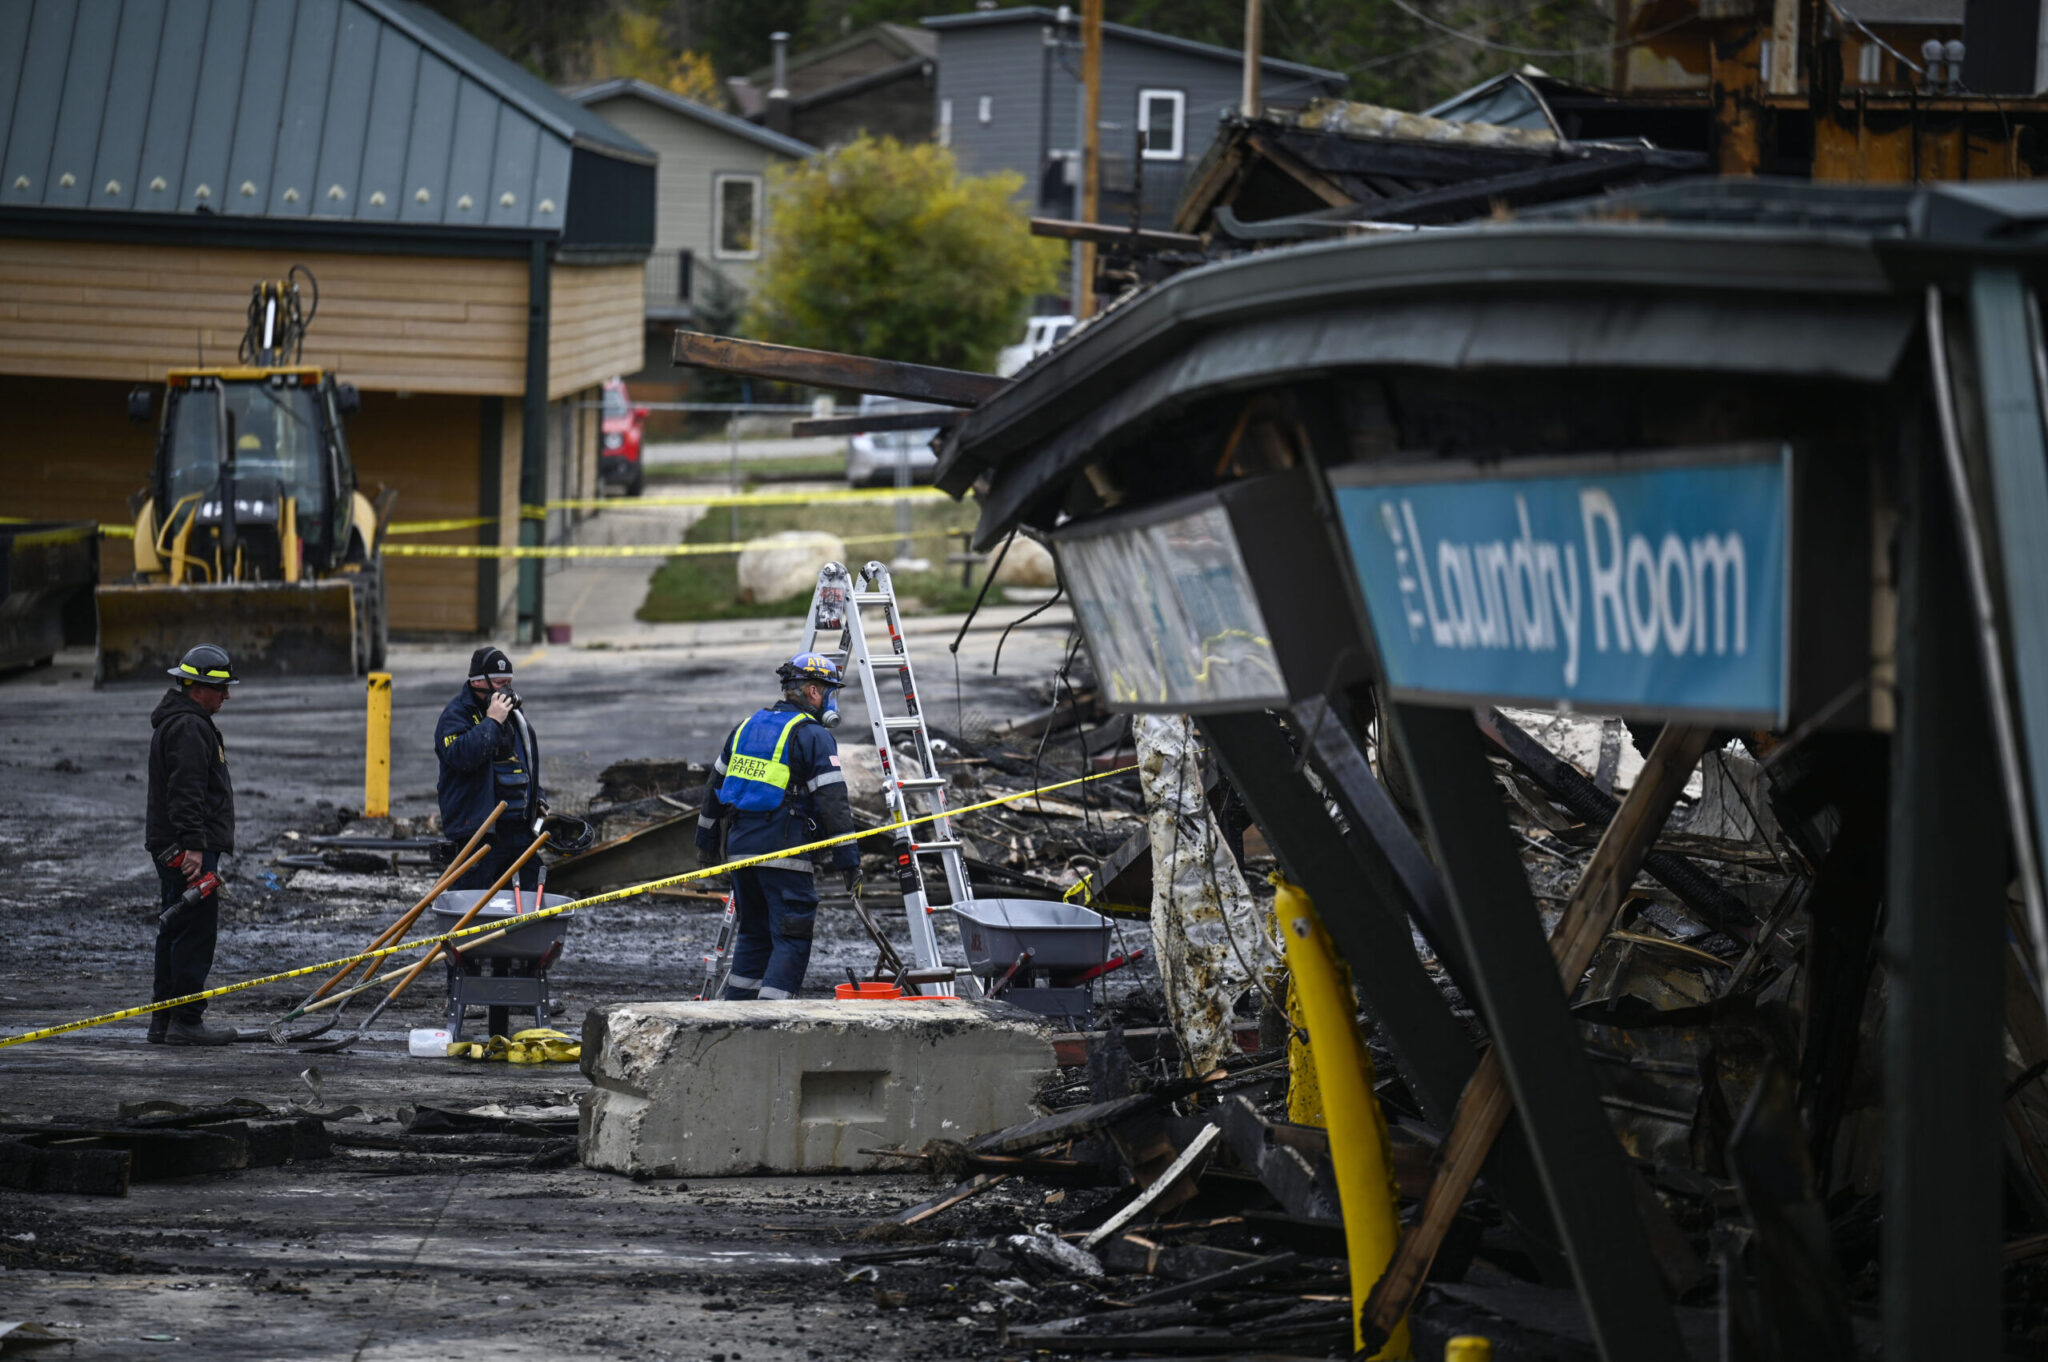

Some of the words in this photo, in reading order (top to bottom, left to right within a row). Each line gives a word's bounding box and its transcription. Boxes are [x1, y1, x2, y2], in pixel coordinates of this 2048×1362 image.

[1400, 492, 1581, 688] Laundry
[1580, 487, 1748, 656] Room
[808, 657, 827, 668] ATF
[733, 756, 768, 769] SAFETY
[729, 764, 766, 778] OFFICER
